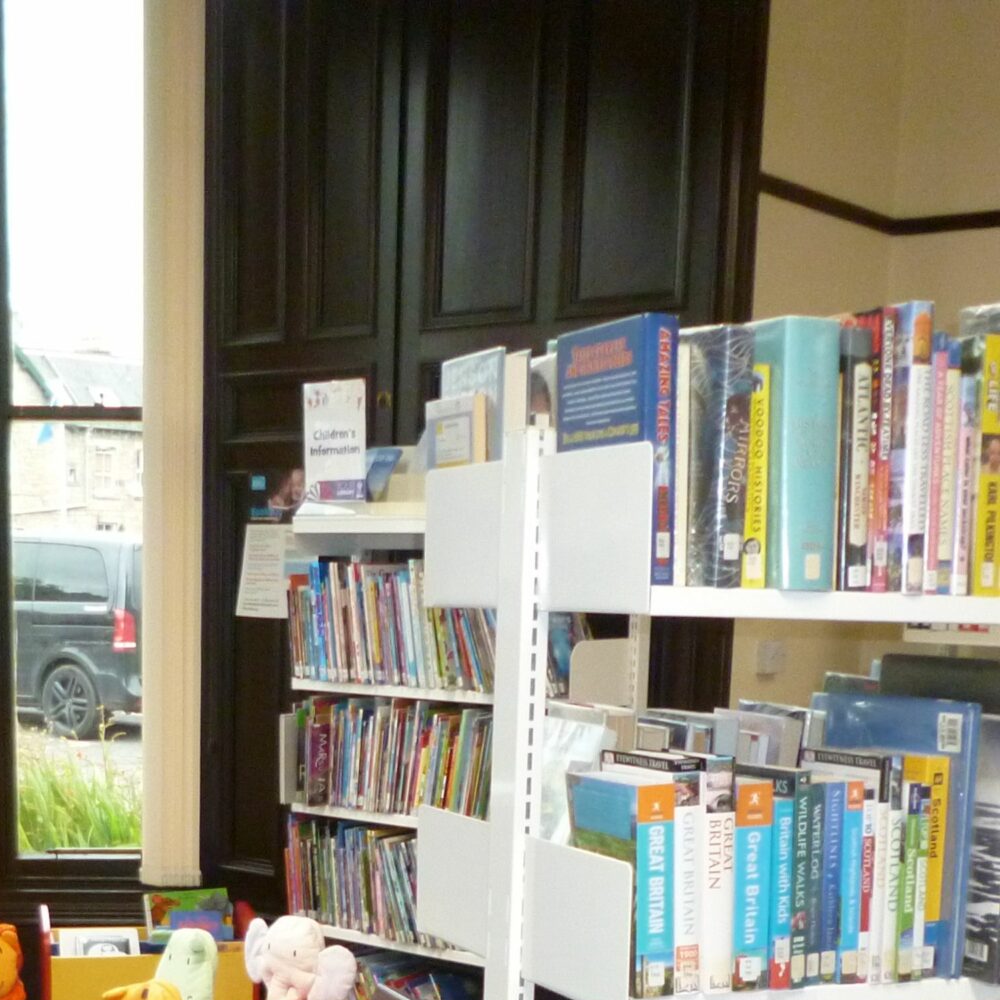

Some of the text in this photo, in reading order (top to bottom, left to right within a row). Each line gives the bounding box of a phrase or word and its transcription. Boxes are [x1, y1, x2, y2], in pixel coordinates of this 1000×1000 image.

[656, 327, 672, 444] AMAZING TALES
[856, 374, 870, 452] ATLANTIC
[986, 380, 999, 412] LIFE
[310, 445, 360, 456] Information
[313, 429, 356, 441] Children's
[751, 398, 765, 534] VOODOO HISTORIES
[986, 482, 998, 505] KARL
[616, 754, 669, 770] EYEWITNESS TRAVEL
[816, 751, 877, 767] EYEWITNESS TRAVEL
[709, 820, 722, 889] BRITAIN
[723, 817, 733, 870] GREAT
[795, 796, 808, 908] WILDLIFE WALKS
[810, 804, 822, 880] WATERLOG
[929, 798, 942, 859] Scotland
[647, 825, 665, 934] GREAT BRITAIN
[683, 812, 695, 936] GREAT BRITAIN
[744, 831, 762, 944] Great Britain
[777, 816, 792, 924] Britain with Kids
[862, 838, 872, 893] SCOTLAND
[887, 817, 901, 912] SCOTLAND
[904, 848, 917, 913] Scotland
